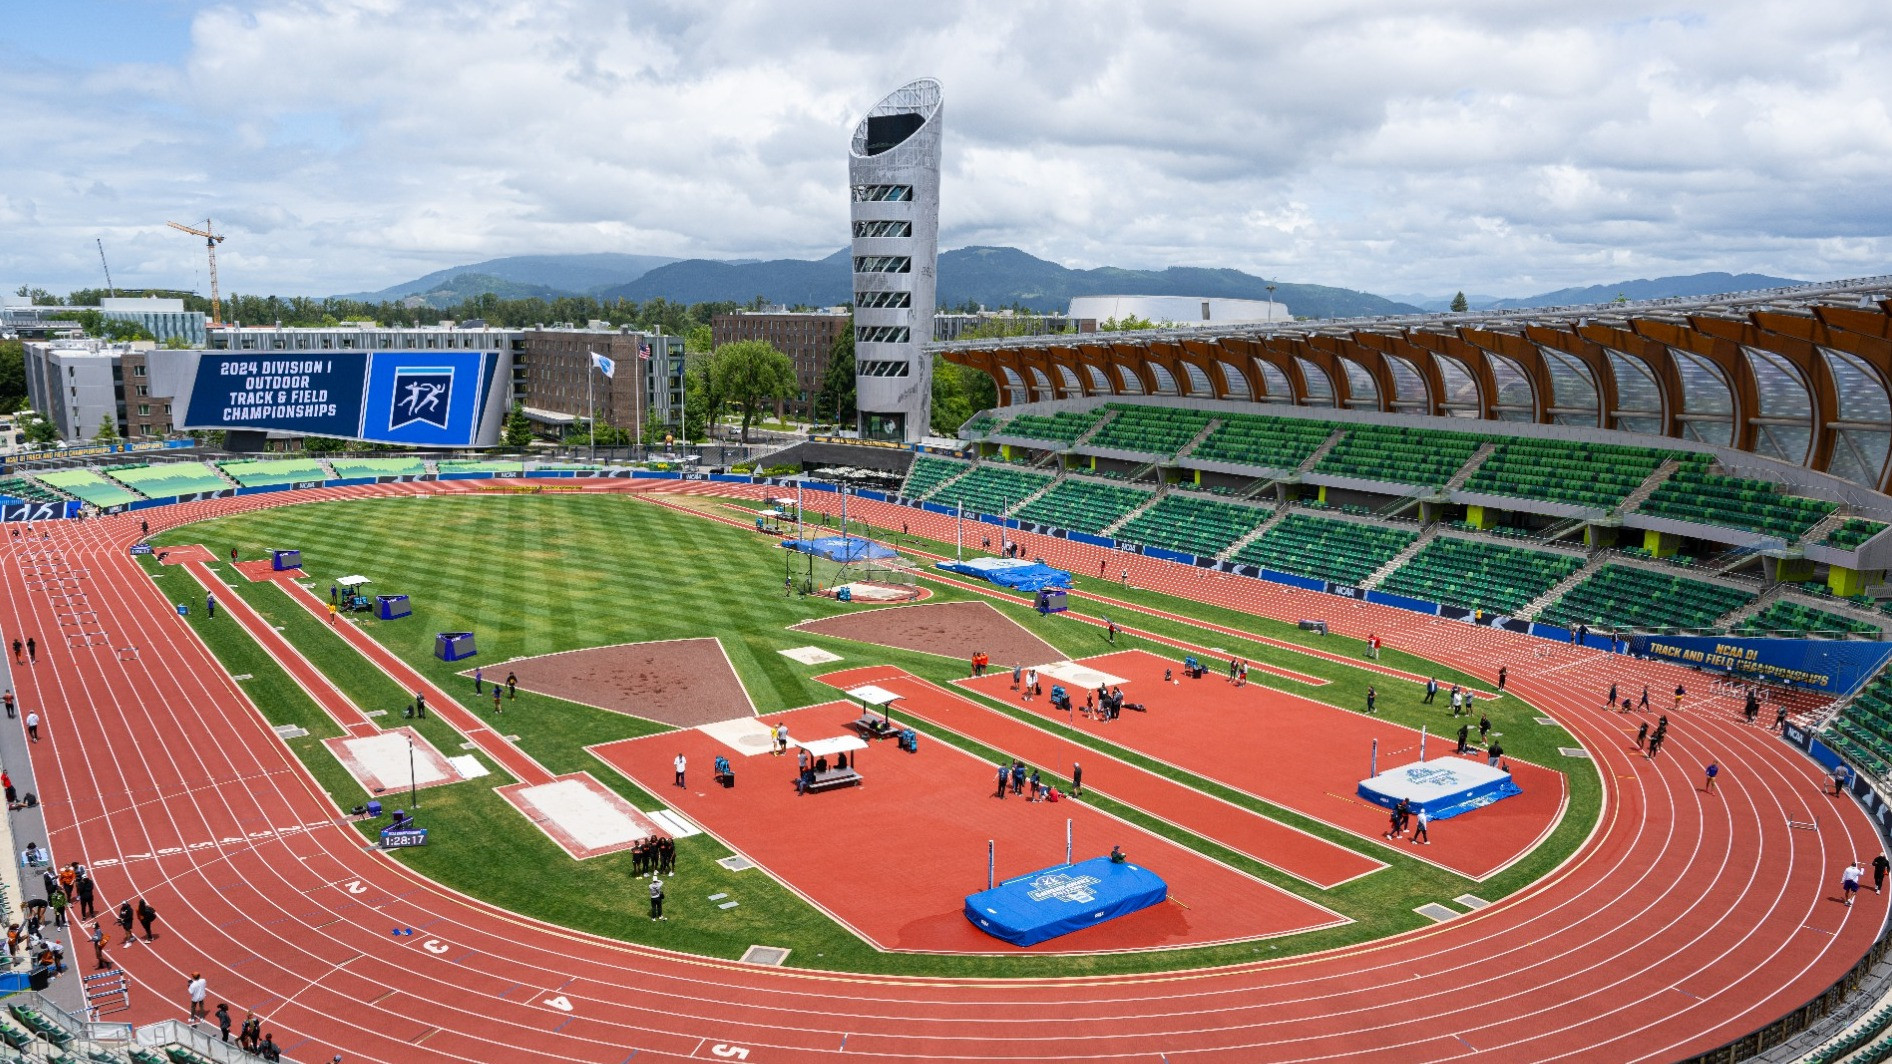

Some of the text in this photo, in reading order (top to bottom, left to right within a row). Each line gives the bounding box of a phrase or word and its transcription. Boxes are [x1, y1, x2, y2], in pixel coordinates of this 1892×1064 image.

[221, 361, 332, 375] 2024 DIVISION I
[246, 375, 310, 390] OUTDOOR
[230, 390, 328, 405] TRACK & FIELD
[223, 404, 337, 421] CHAMPIONSHIPS
[1121, 542, 1136, 552] NCAA
[1334, 585, 1355, 597] NCAA
[1650, 642, 1681, 658] TRACK
[1683, 649, 1704, 662] AND
[1705, 653, 1734, 667] FIELD
[1715, 643, 1758, 661] NCAA DI
[1787, 726, 1803, 744] NCAA
[385, 835, 425, 846] 1:28:17
[345, 880, 367, 894] 2
[423, 939, 449, 954] 3
[543, 996, 573, 1012] 4
[711, 1043, 750, 1060] 5
